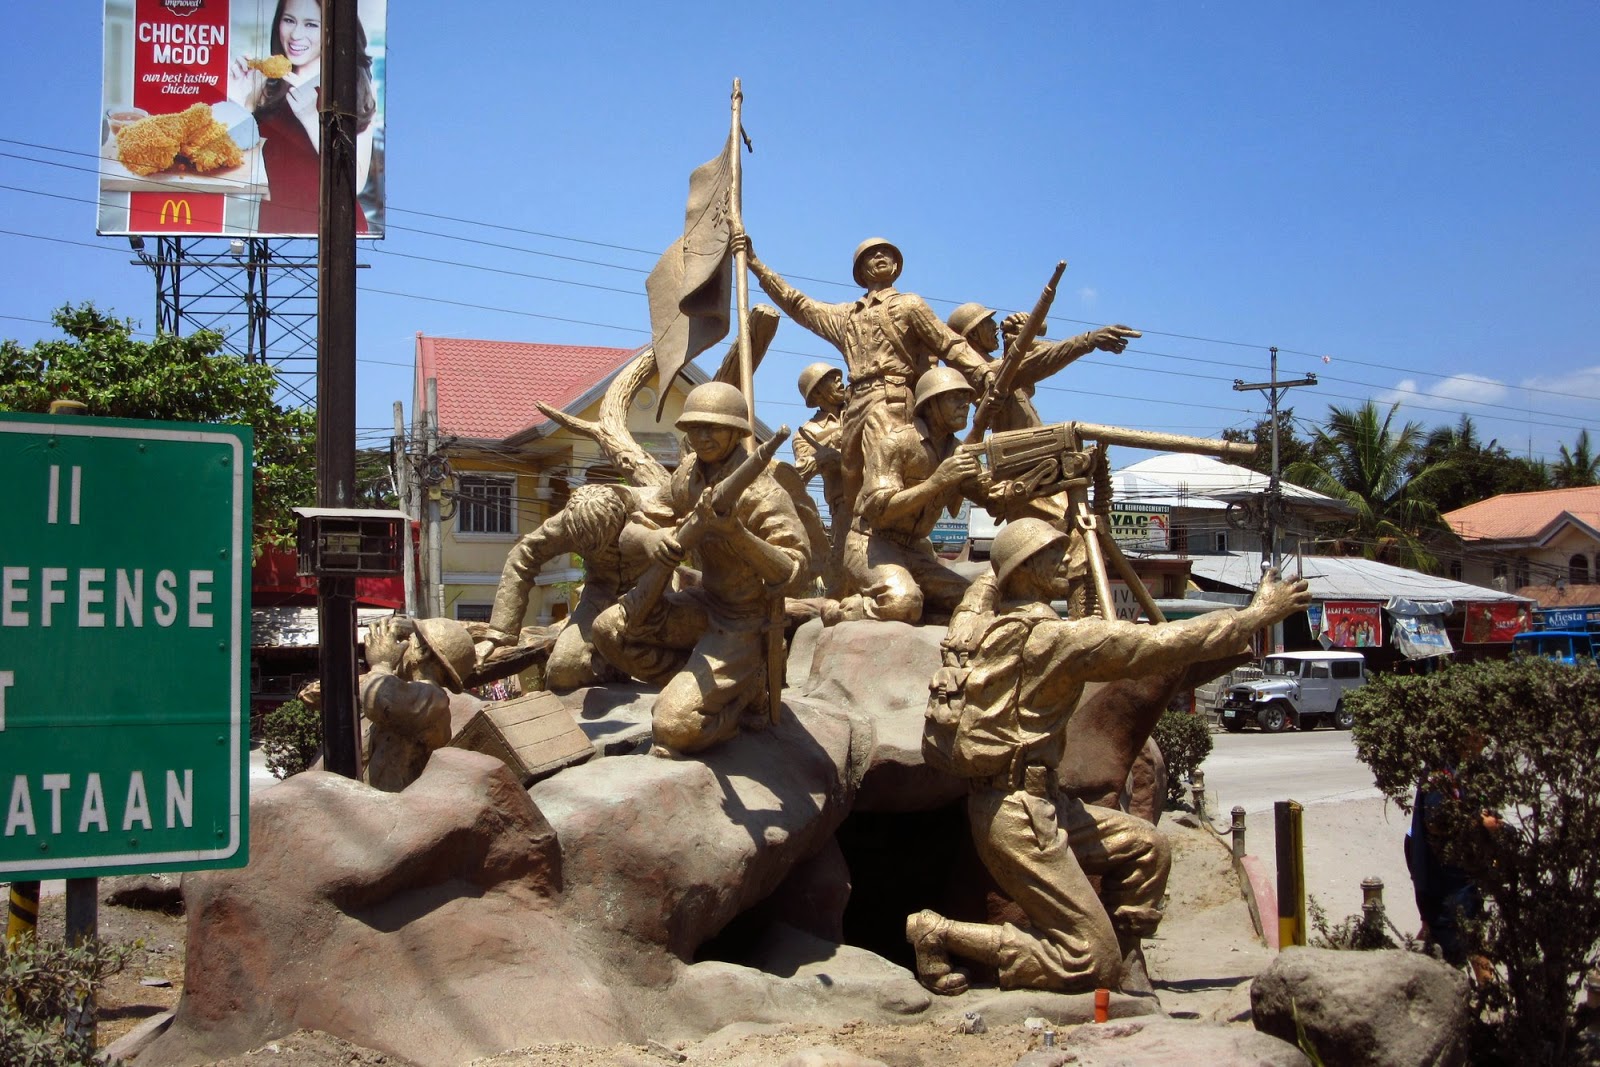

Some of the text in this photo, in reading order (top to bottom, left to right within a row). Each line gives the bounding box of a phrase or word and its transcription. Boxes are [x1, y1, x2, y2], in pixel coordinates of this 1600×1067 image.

[139, 22, 225, 45] CHICKEN
[142, 72, 219, 86] our best tasting
[161, 83, 200, 95] chicken
[1109, 515, 1148, 527] YAC
[2, 566, 215, 628] EFENSE
[1554, 612, 1583, 621] fiesta
[4, 769, 194, 836] ATAAN
